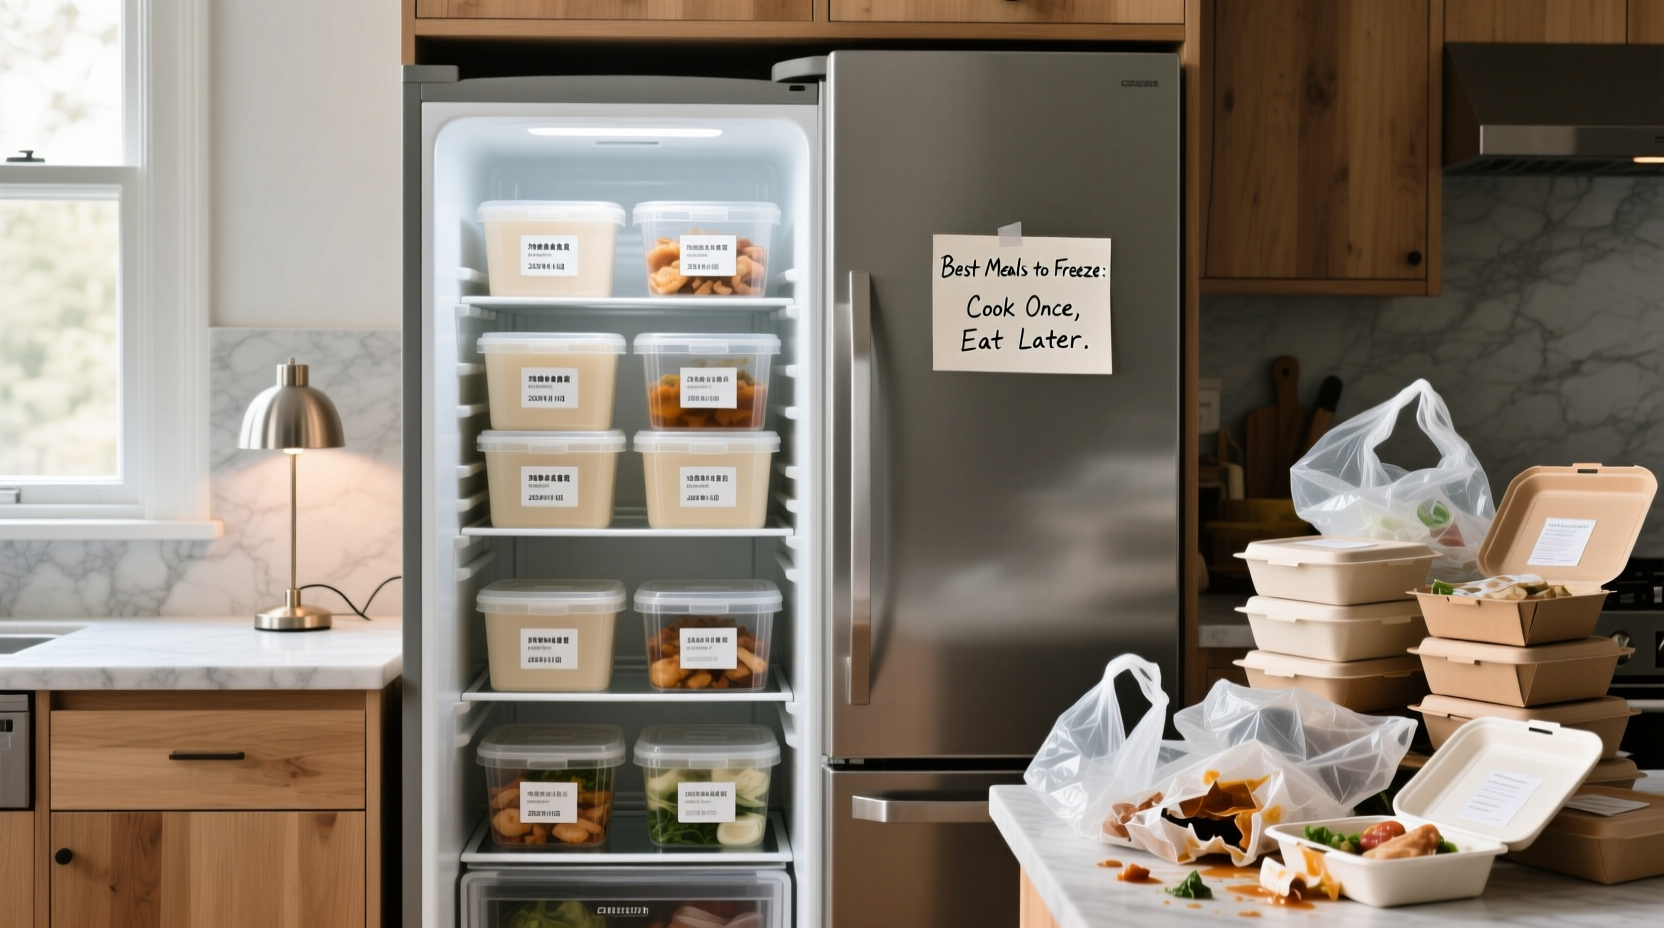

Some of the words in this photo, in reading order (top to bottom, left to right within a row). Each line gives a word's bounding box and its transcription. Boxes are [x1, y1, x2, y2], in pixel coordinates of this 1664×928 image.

[941, 254, 981, 279] Best
[985, 257, 1029, 277] Meals
[1033, 261, 1049, 277] to
[1054, 258, 1107, 278] Freeze:
[967, 294, 1016, 318] Cook
[1026, 294, 1081, 322] Once,
[961, 328, 1004, 352] Eat
[1018, 327, 1090, 350] Later.
